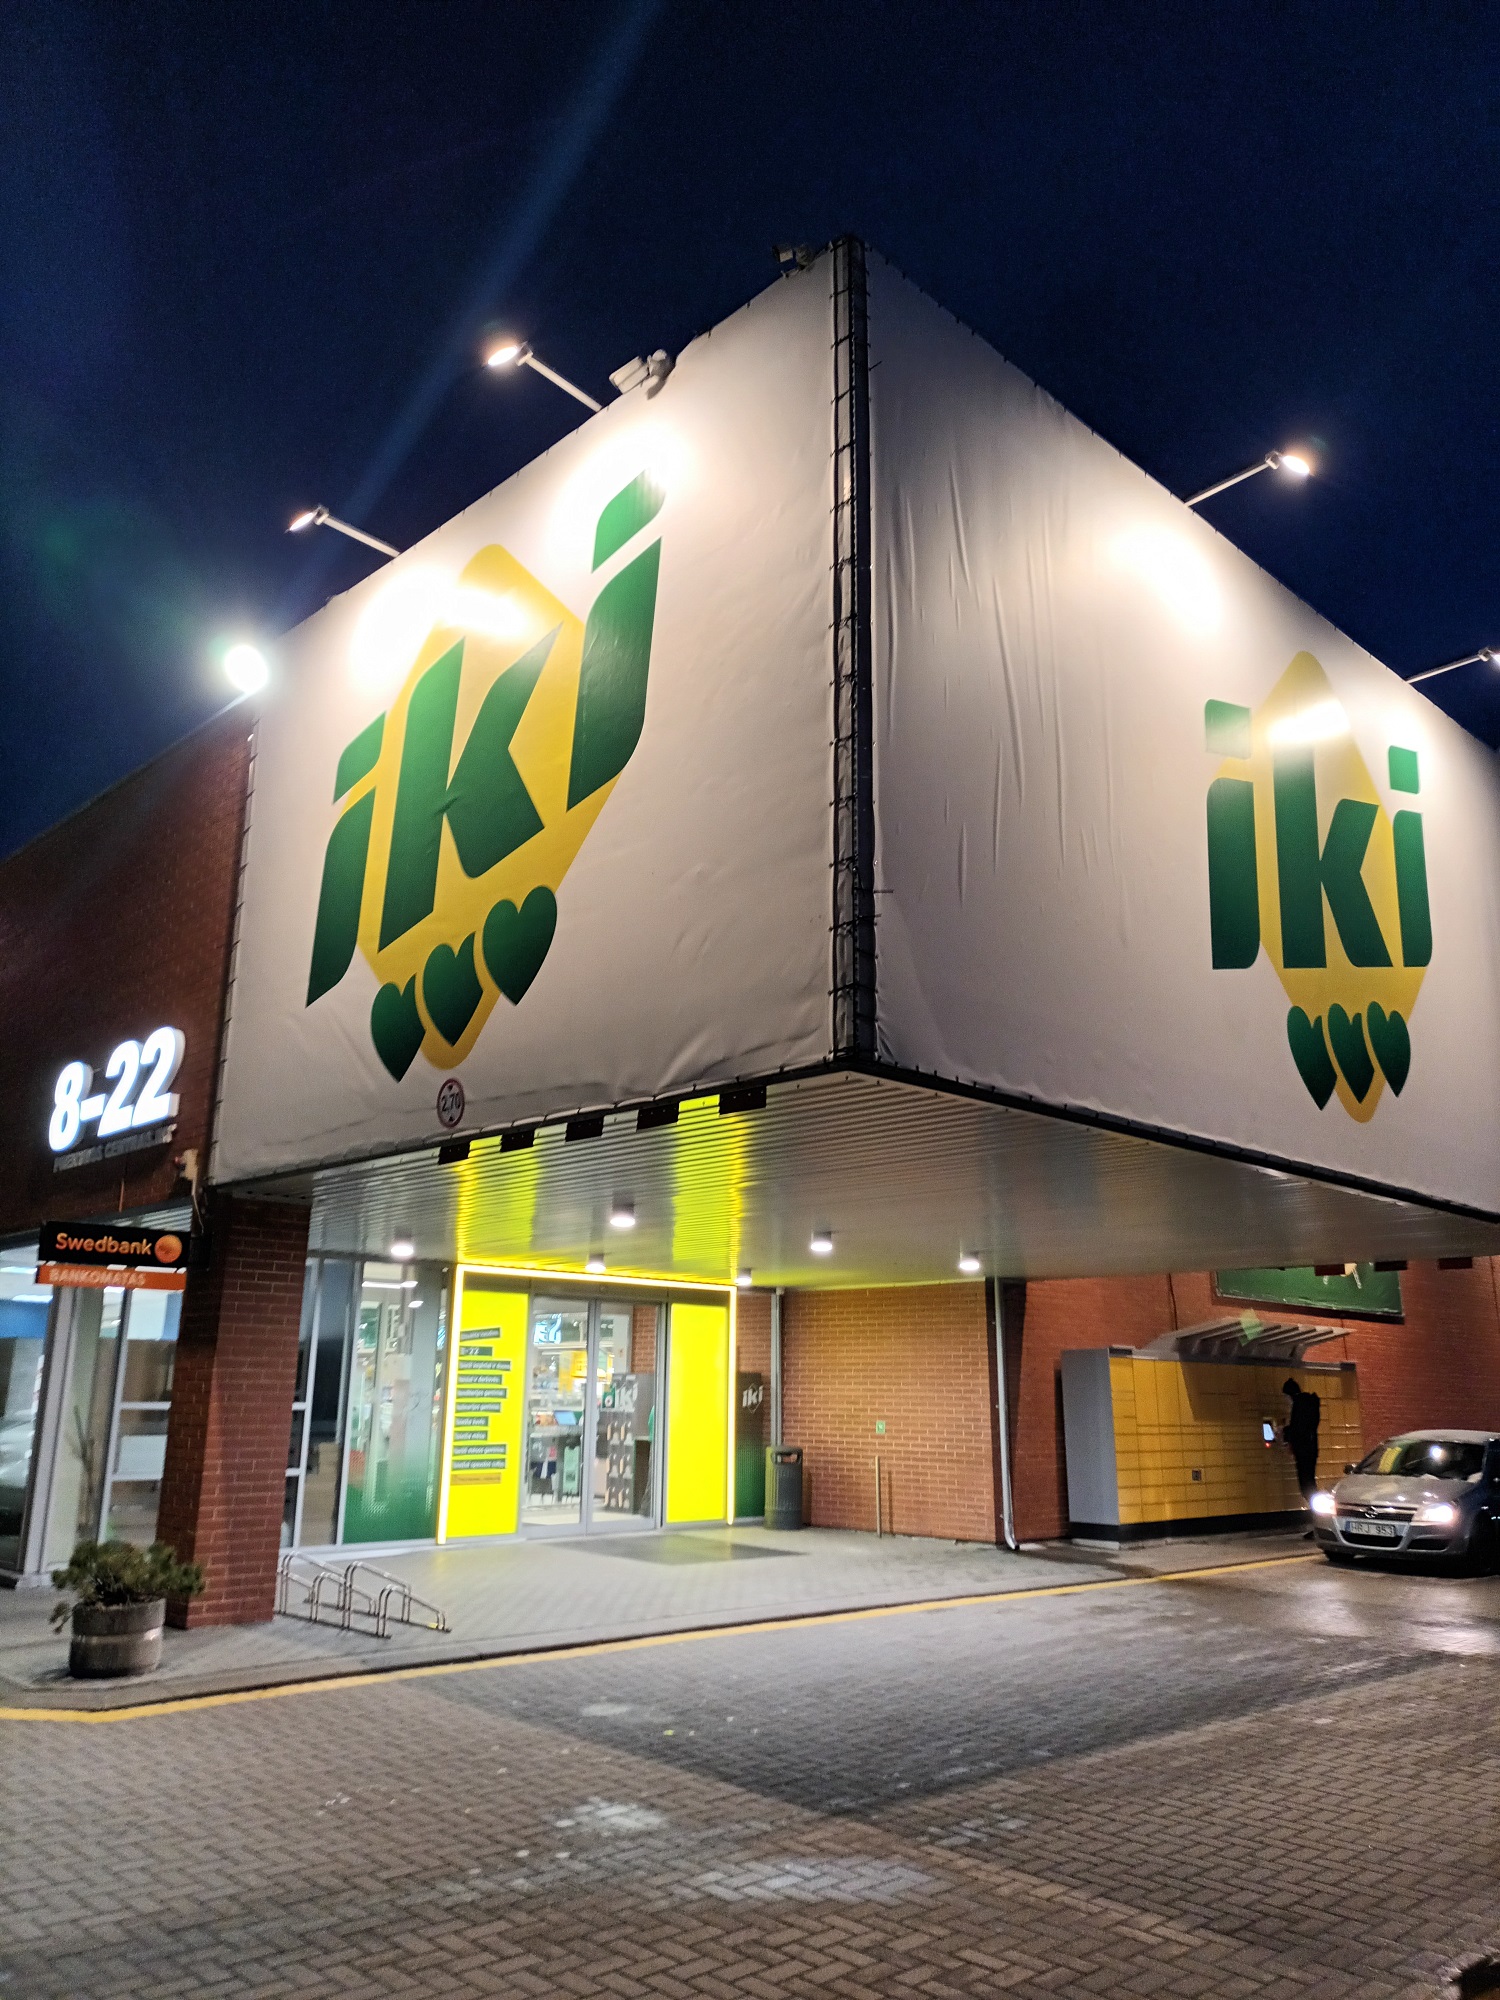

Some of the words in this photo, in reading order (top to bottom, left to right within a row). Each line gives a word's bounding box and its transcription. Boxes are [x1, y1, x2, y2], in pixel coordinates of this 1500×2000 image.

[49, 1026, 182, 1151] 8-22
[55, 1232, 152, 1256] Swedbank
[51, 1267, 146, 1287] BANKOMATAS
